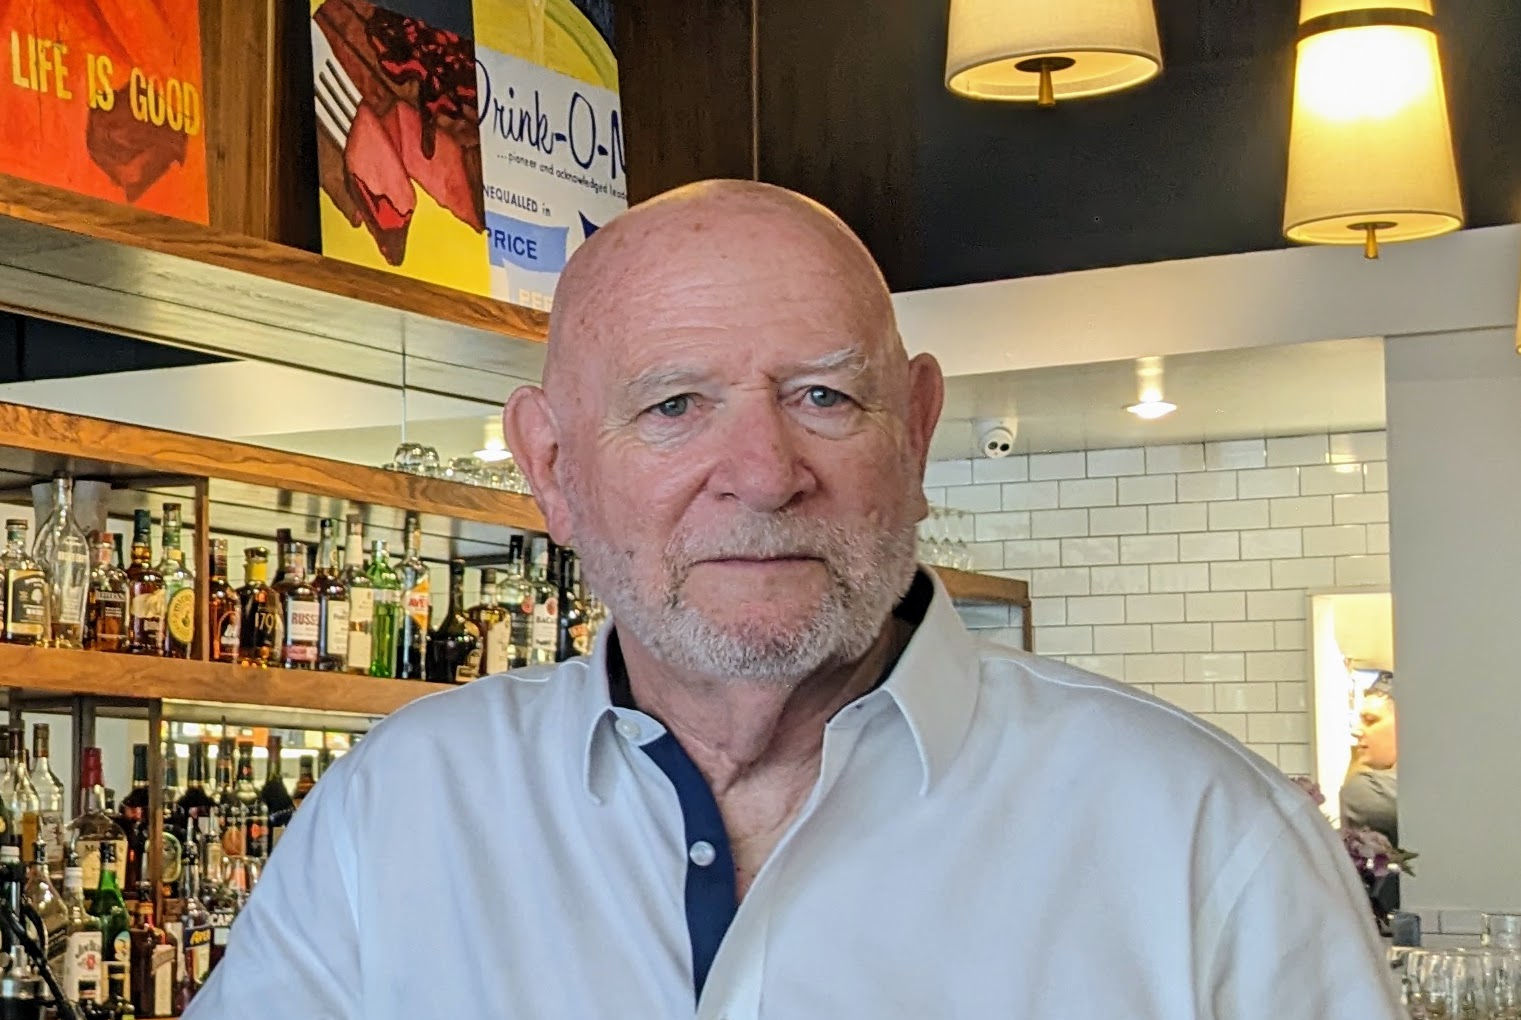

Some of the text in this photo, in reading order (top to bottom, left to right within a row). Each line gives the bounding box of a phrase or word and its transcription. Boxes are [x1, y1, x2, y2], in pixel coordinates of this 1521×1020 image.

[11, 31, 200, 136] LIFE IS GOOD
[540, 163, 554, 175] and
[542, 202, 551, 217] in
